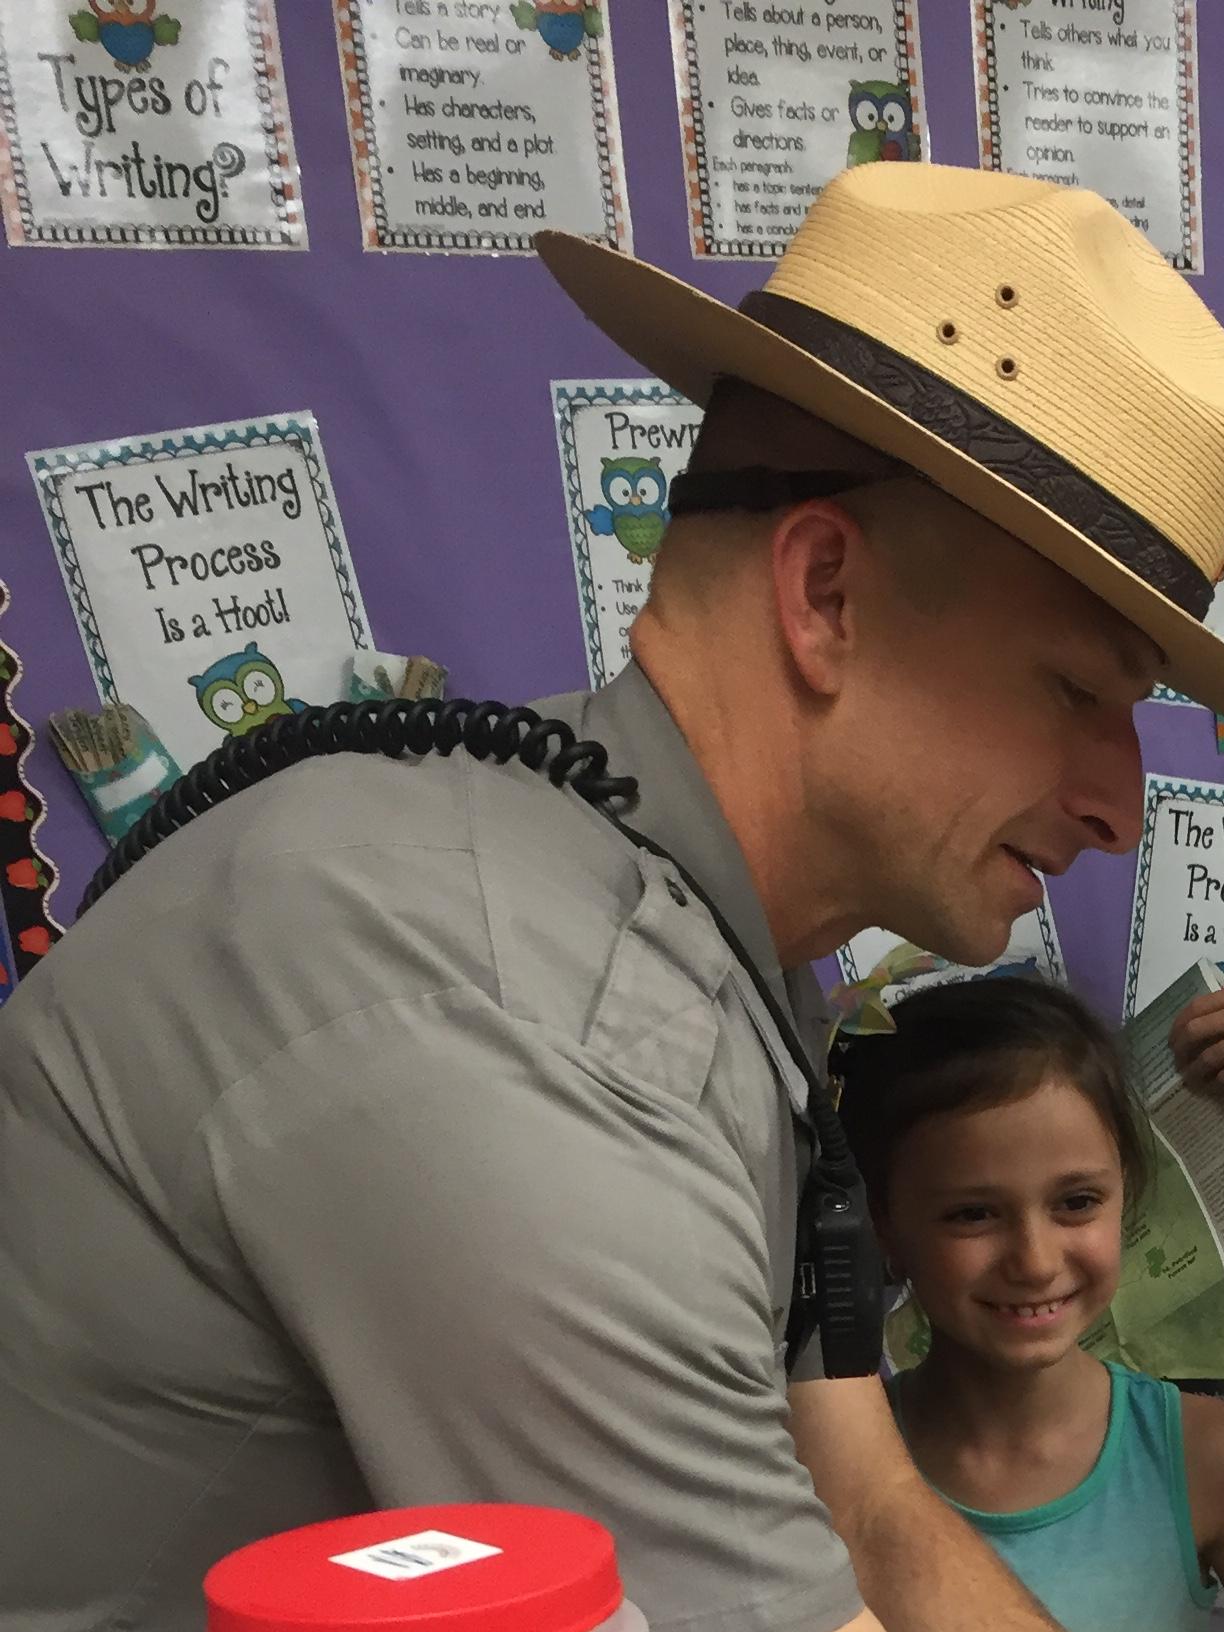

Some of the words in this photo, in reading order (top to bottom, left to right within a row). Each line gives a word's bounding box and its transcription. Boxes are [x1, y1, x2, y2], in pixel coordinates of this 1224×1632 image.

[720, 1, 757, 22] Tells
[763, 5, 804, 25] about
[811, 12, 821, 26] a
[826, 12, 883, 34] person,
[395, 26, 431, 49] Can
[437, 29, 459, 51] be
[466, 33, 499, 53] real
[505, 38, 526, 55] or
[724, 33, 768, 58] place,
[772, 35, 812, 62] thing,
[817, 42, 863, 63] event,
[868, 46, 887, 62] or
[1020, 19, 1052, 41] Tells
[1057, 22, 1102, 45] others
[1107, 28, 1138, 48] what
[1144, 34, 1171, 52] you
[37, 52, 172, 137] Types
[184, 56, 231, 117] of
[404, 93, 436, 117] Has
[441, 95, 536, 124] characters,
[731, 95, 773, 119] Gives
[778, 99, 816, 122] facts
[821, 105, 839, 122] or
[1022, 80, 1059, 103] Tries
[1063, 85, 1079, 104] to
[1084, 90, 1143, 110] convince
[1148, 92, 1170, 110] the
[407, 130, 466, 156] setting,
[471, 130, 501, 152] and
[507, 138, 518, 152] a
[1024, 113, 1072, 133] reader
[1078, 116, 1093, 134] to
[1097, 120, 1149, 142] support
[1154, 124, 1170, 140] an
[40, 141, 247, 224] Writing?
[412, 160, 443, 183] Has
[449, 168, 460, 184] a
[466, 163, 545, 192] beginning,
[415, 195, 472, 219] middle,
[478, 197, 508, 217] and
[604, 411, 701, 450] Prewr
[75, 481, 154, 530] The
[155, 462, 302, 520] Writing
[130, 540, 282, 590] Process
[612, 578, 643, 594] Think
[155, 607, 185, 644] Is
[192, 612, 212, 637] a
[212, 588, 291, 635] Hoot!
[1168, 808, 1214, 850] The
[1183, 913, 1199, 942] Is
[1204, 925, 1217, 944] a
